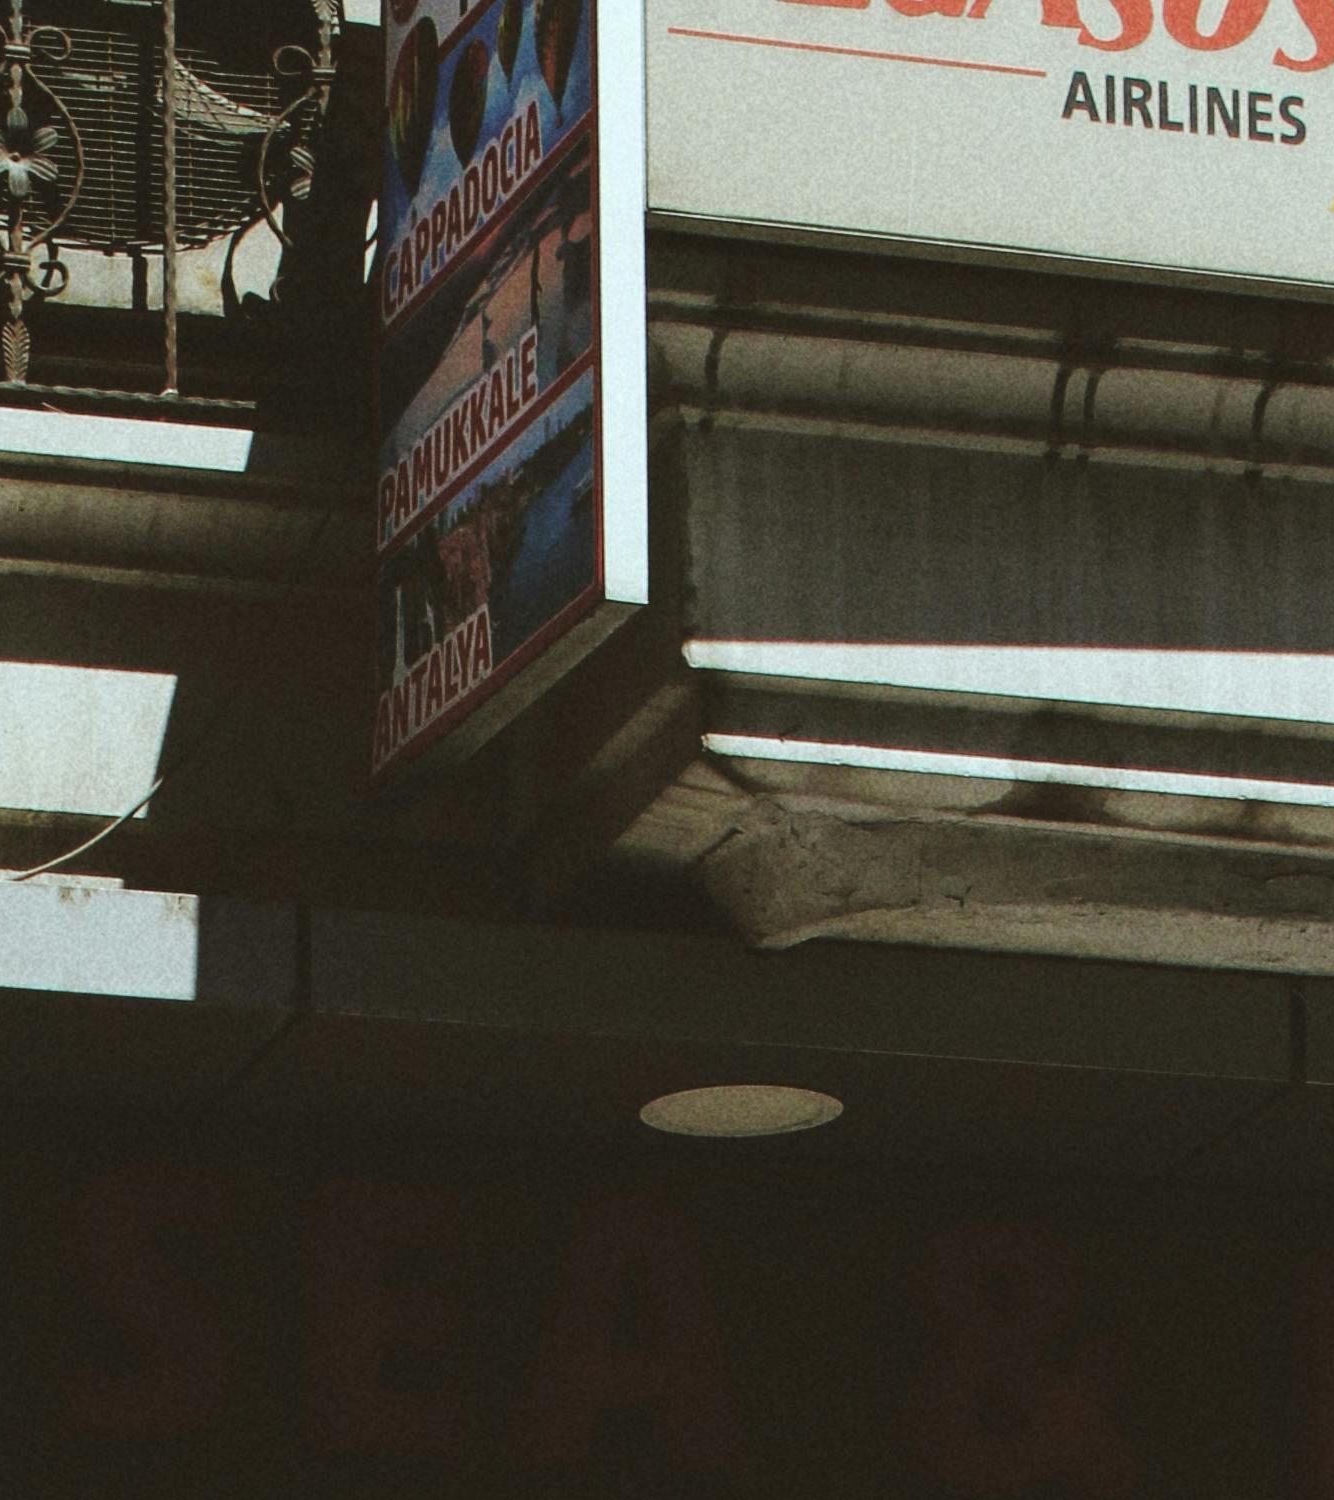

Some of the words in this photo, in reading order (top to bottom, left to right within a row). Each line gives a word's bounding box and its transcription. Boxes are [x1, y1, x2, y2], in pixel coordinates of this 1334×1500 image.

[385, 102, 542, 316] CAPPADOCIA
[1062, 71, 1308, 145] AIRLINES
[378, 331, 537, 545] PAMUKKALE
[375, 608, 491, 770] ANTALYA
[66, 1156, 746, 1464] SEA
